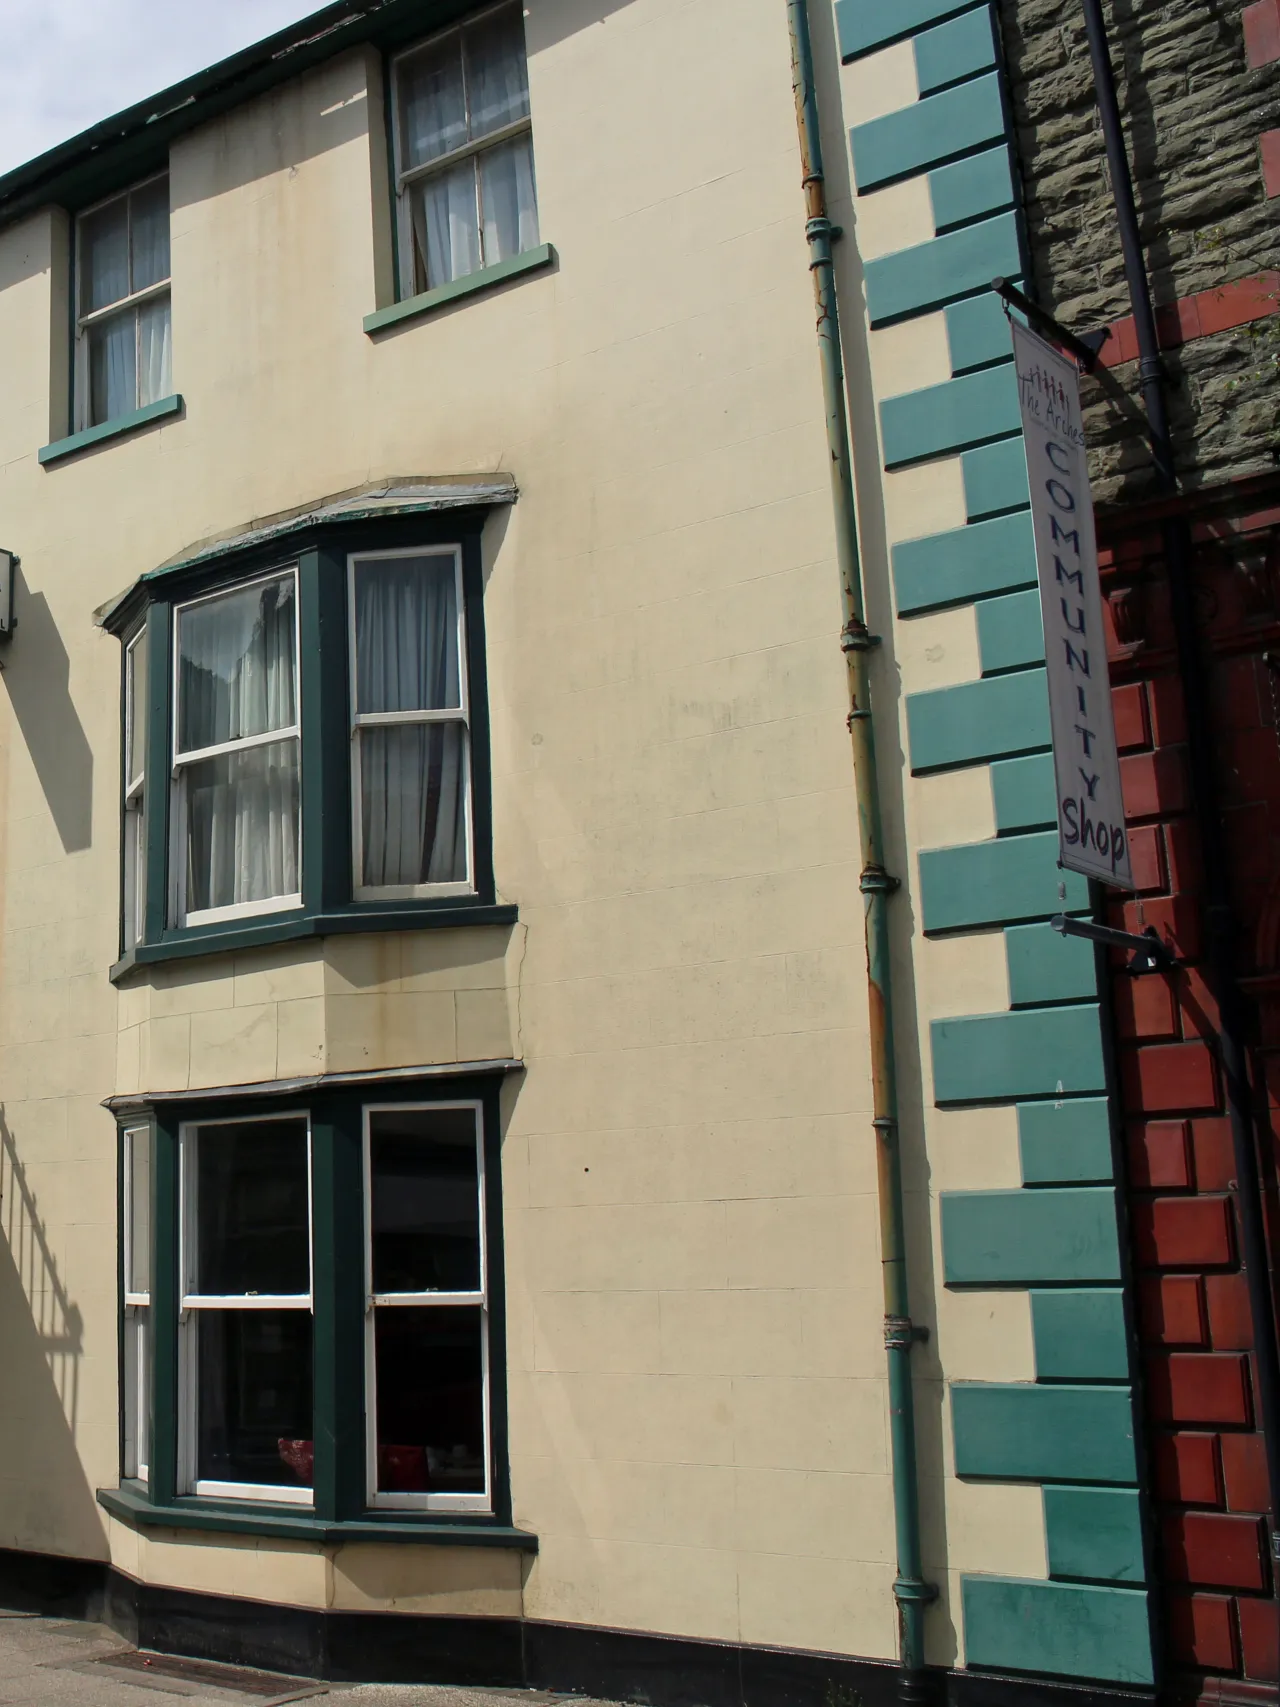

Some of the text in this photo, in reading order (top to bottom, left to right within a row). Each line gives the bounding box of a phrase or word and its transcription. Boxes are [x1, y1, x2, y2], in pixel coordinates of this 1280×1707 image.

[1018, 372, 1040, 416] The
[1046, 395, 1085, 446] Arches
[1045, 441, 1100, 801] COMMUNITY
[1062, 797, 1125, 876] Shop
